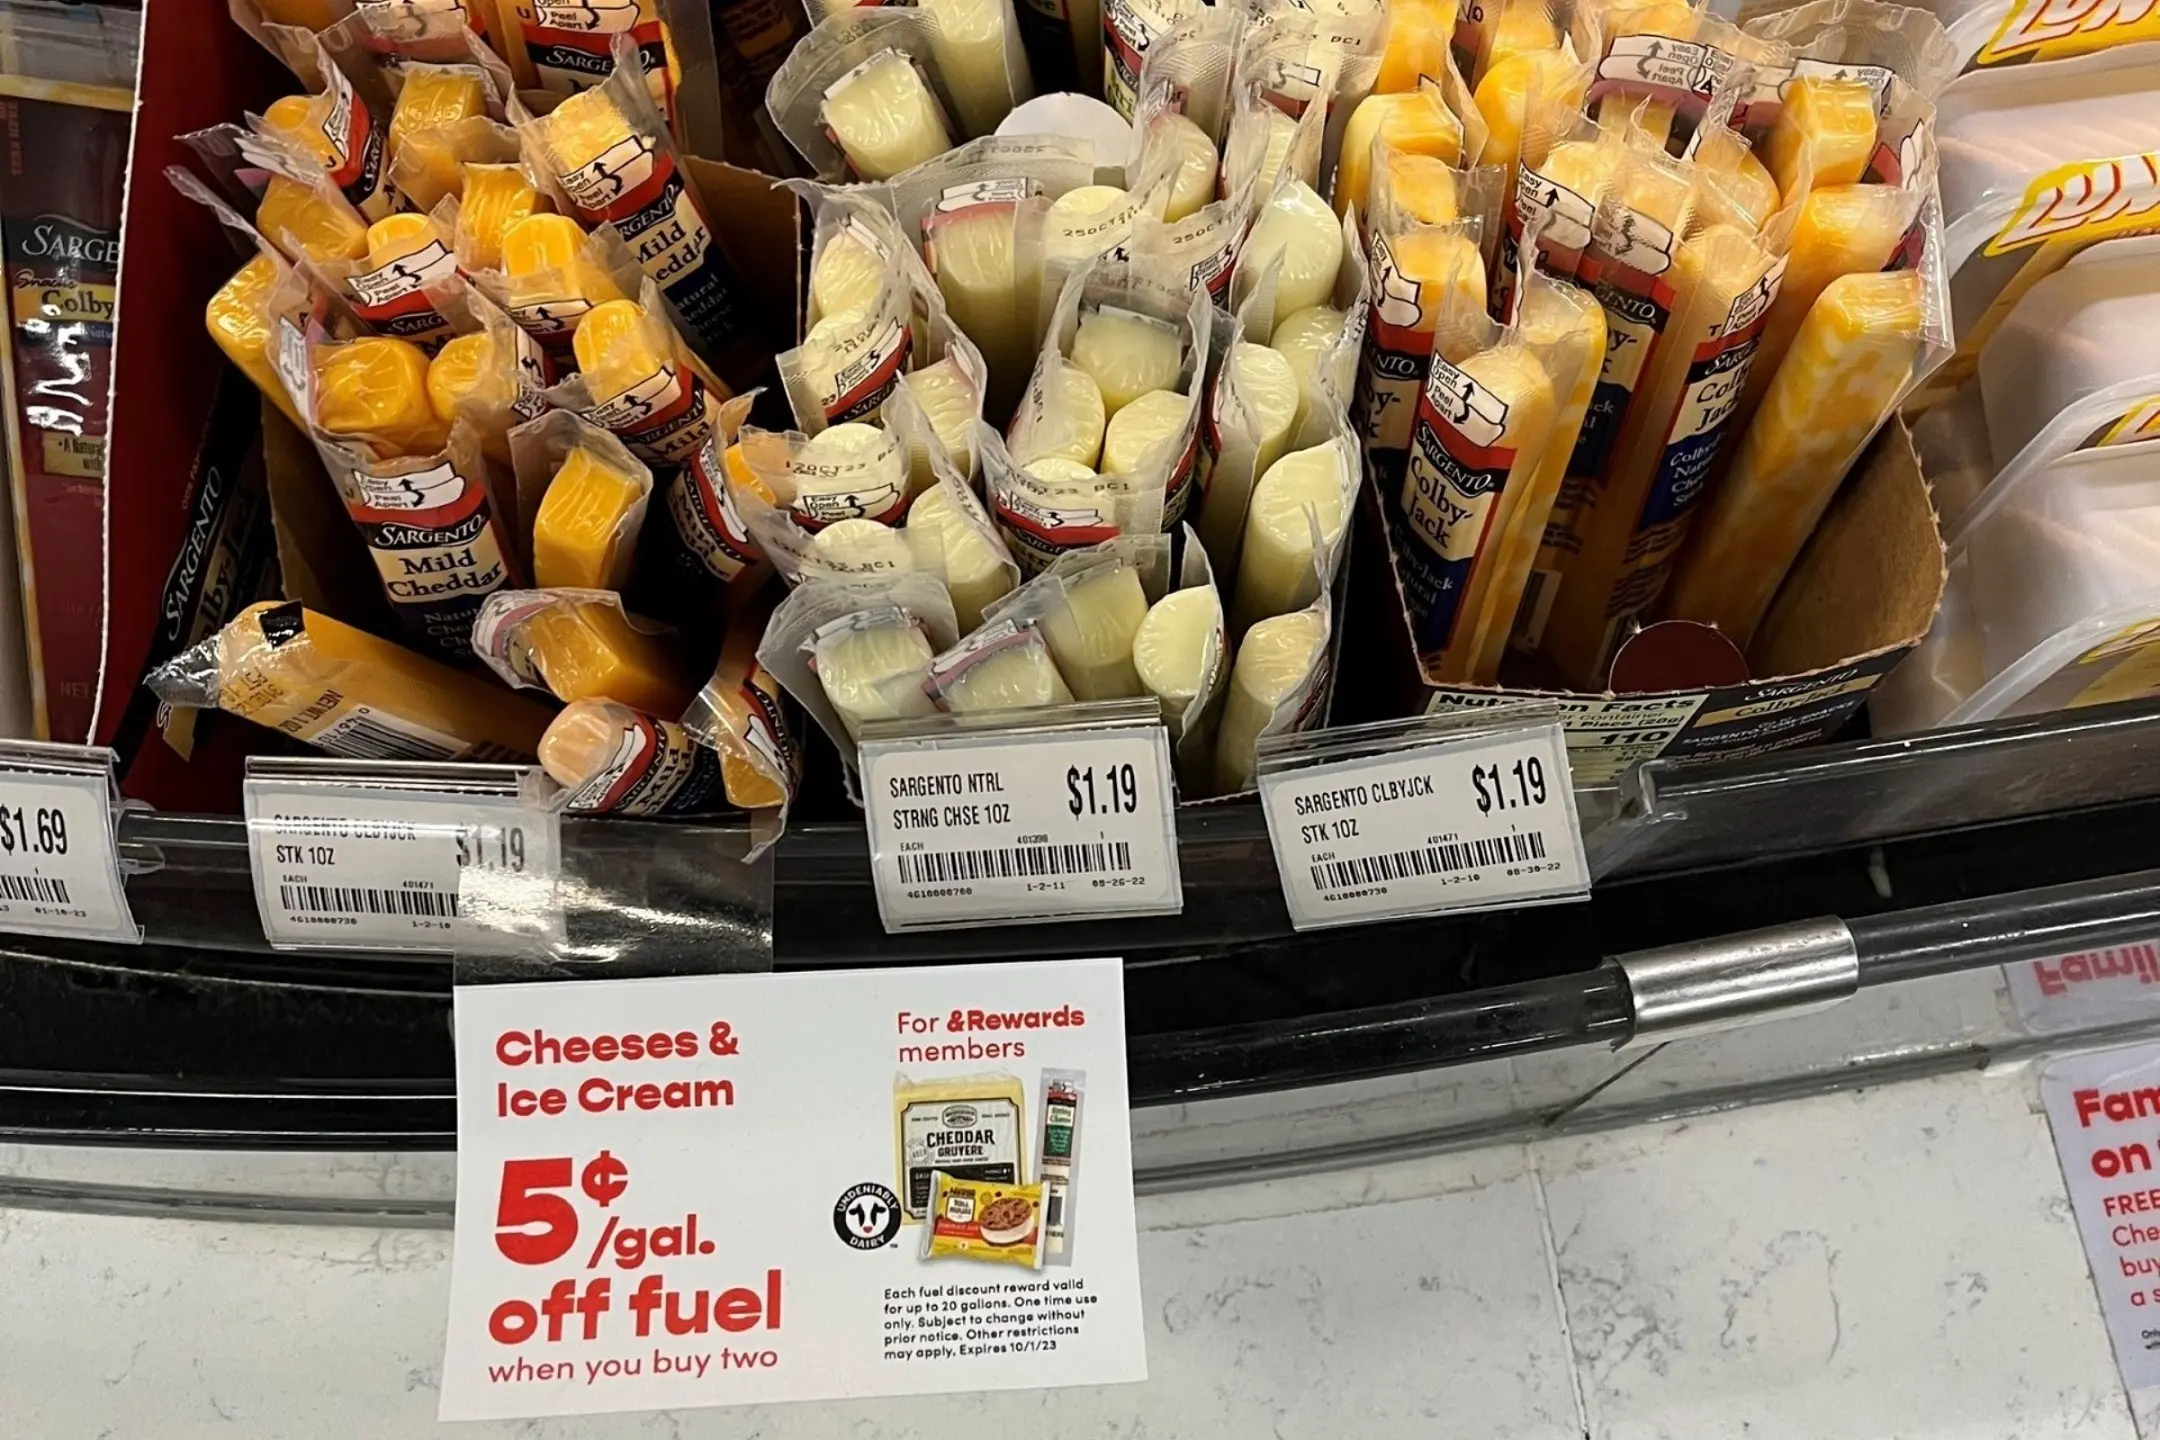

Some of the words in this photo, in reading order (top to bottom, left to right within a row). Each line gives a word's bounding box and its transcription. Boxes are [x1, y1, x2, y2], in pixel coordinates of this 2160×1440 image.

[549, 11, 578, 22] Peel
[619, 184, 680, 238] RGENTO
[1433, 365, 1457, 388] Open
[1435, 358, 1460, 380] Easy
[1433, 385, 1454, 408] Peel
[1417, 424, 1492, 491] SARGENTO
[1411, 454, 1474, 528] Colby-
[375, 513, 483, 547] SARGENTO
[399, 548, 478, 576] Mild
[387, 562, 503, 599] Cheddar
[1577, 710, 1663, 723] container
[1601, 698, 1695, 714] Facts
[1580, 719, 1627, 729] Piece
[1600, 729, 1671, 746] 110
[889, 773, 963, 798] SARGENTO
[968, 771, 1004, 793] NTRL
[1066, 763, 1138, 821] $1.19
[1294, 785, 1368, 816] SARGENTO
[1371, 774, 1435, 804] CLBYJCK
[1471, 756, 1548, 818] $1.19
[893, 807, 939, 830] STRNG
[944, 804, 980, 826] CHSE
[0, 803, 69, 856] $1.69
[1300, 823, 1330, 845] STK
[276, 844, 303, 865] STK
[900, 841, 925, 852] EACH
[1311, 851, 1336, 863] EACH
[282, 874, 308, 884] EACH
[898, 1011, 940, 1034] For
[946, 1004, 1086, 1034] &Rewards
[495, 1028, 700, 1067] Cheeses
[708, 1021, 740, 1056] &
[899, 1036, 1026, 1063] members
[497, 1082, 568, 1118] Ice
[577, 1076, 735, 1114] Cream
[926, 1129, 996, 1148] CHEDDAR
[937, 1145, 984, 1158] GRUYERE
[2091, 1142, 2153, 1179] on
[836, 1183, 899, 1213] UNDENIABLY
[849, 1234, 887, 1249] DAIRY
[884, 1287, 916, 1300] Each
[919, 1285, 944, 1299] fuel
[946, 1283, 1001, 1297] discount
[1003, 1280, 1050, 1294] reward
[1052, 1278, 1085, 1291] valid
[2130, 1291, 2147, 1307] a
[488, 1277, 612, 1346] off
[627, 1268, 783, 1337] fuel
[884, 1303, 904, 1315] for
[906, 1304, 923, 1316] up
[926, 1302, 939, 1313] to
[941, 1300, 957, 1312] 20
[960, 1298, 1012, 1314] gallons.
[1014, 1296, 1042, 1308] One
[1044, 1295, 1073, 1306] time
[1075, 1294, 1098, 1306] use
[884, 1317, 915, 1331] only.
[918, 1315, 967, 1330] Subject
[969, 1314, 983, 1326] to
[985, 1311, 1034, 1326] change
[1037, 1309, 1086, 1322] without
[884, 1333, 917, 1348] prior
[919, 1331, 963, 1343] notice.
[966, 1328, 1005, 1341] Other
[1007, 1324, 1081, 1338] restrictions
[884, 1348, 913, 1362] may
[959, 1341, 1008, 1357] Expires
[1009, 1339, 1057, 1353] 10/1/23
[488, 1356, 576, 1384] when
[585, 1357, 643, 1386] you
[652, 1348, 712, 1379] buy
[720, 1346, 779, 1371] two
